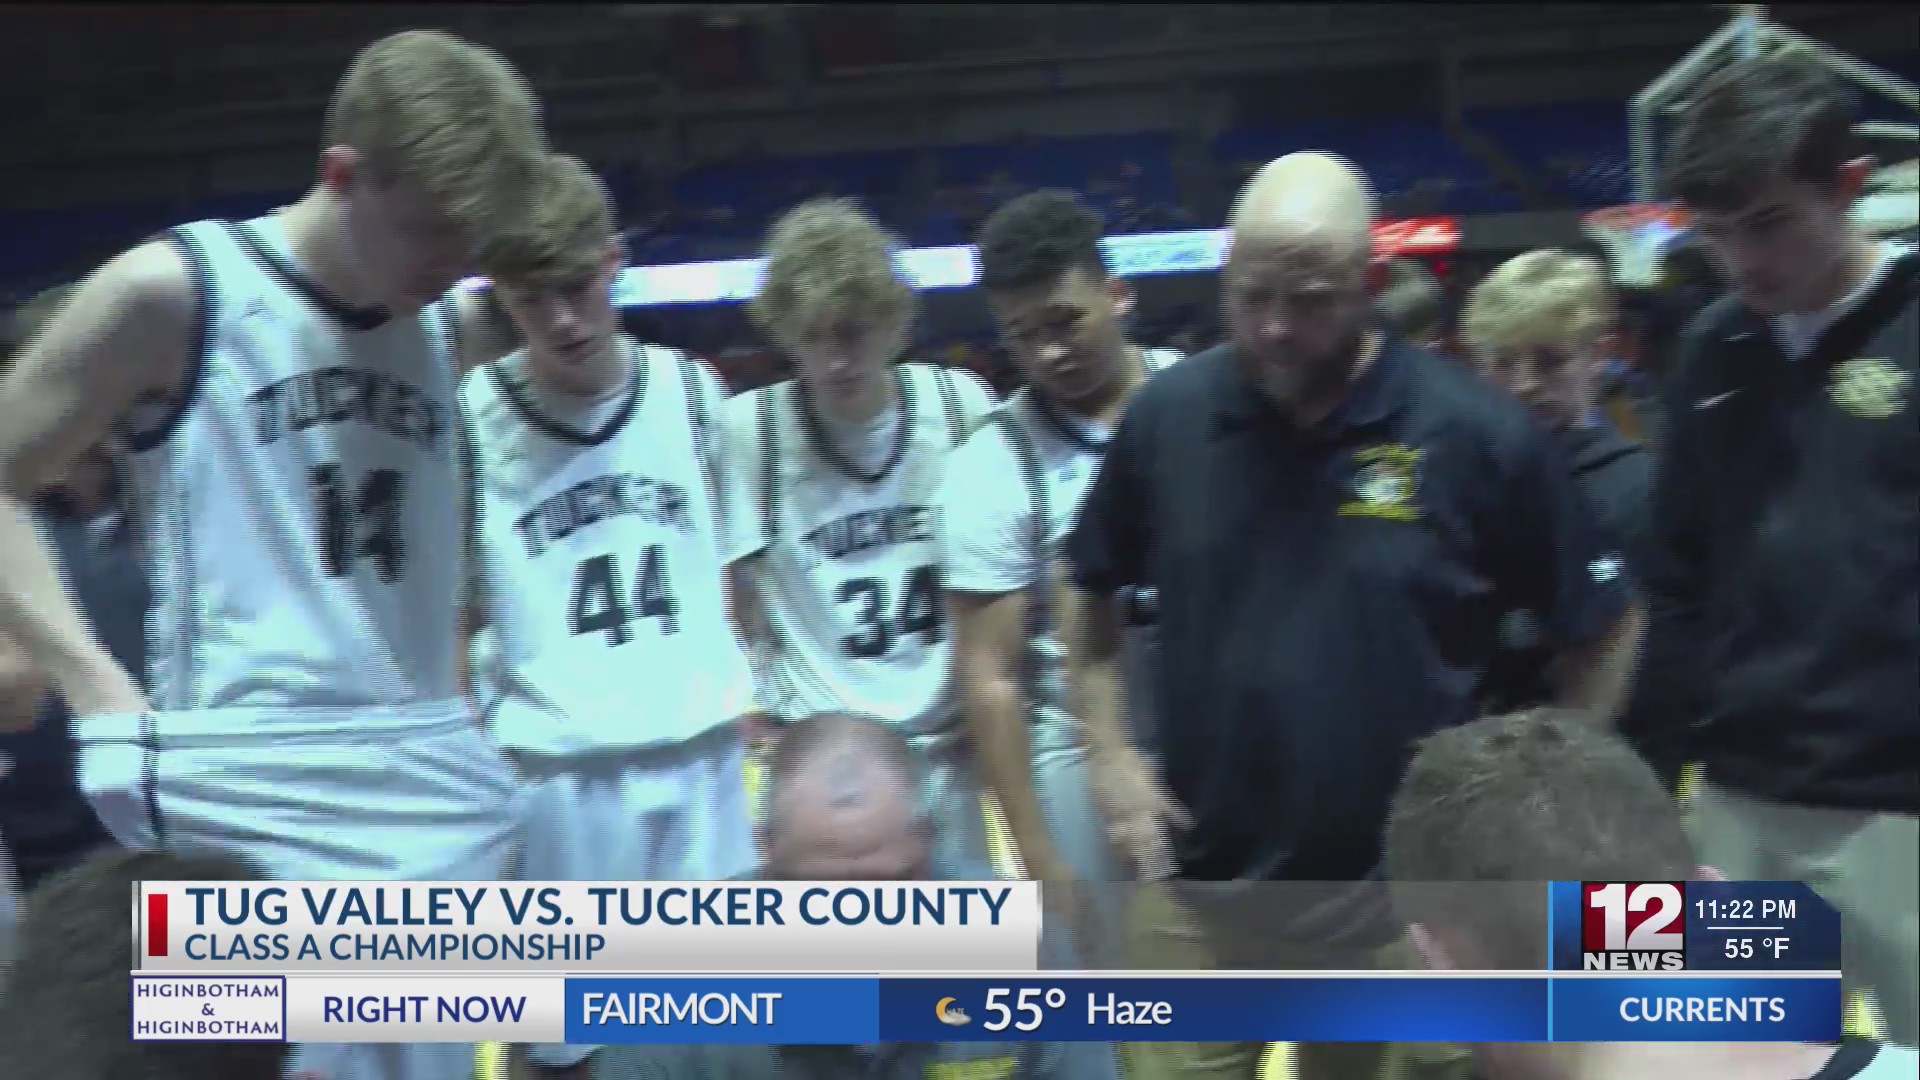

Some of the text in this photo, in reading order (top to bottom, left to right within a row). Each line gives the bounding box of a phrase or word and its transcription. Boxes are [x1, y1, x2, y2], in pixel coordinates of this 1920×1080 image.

[513, 472, 698, 560] TUCKER
[800, 504, 946, 560] TUCKE
[567, 543, 681, 648] 44
[836, 563, 949, 660] 34
